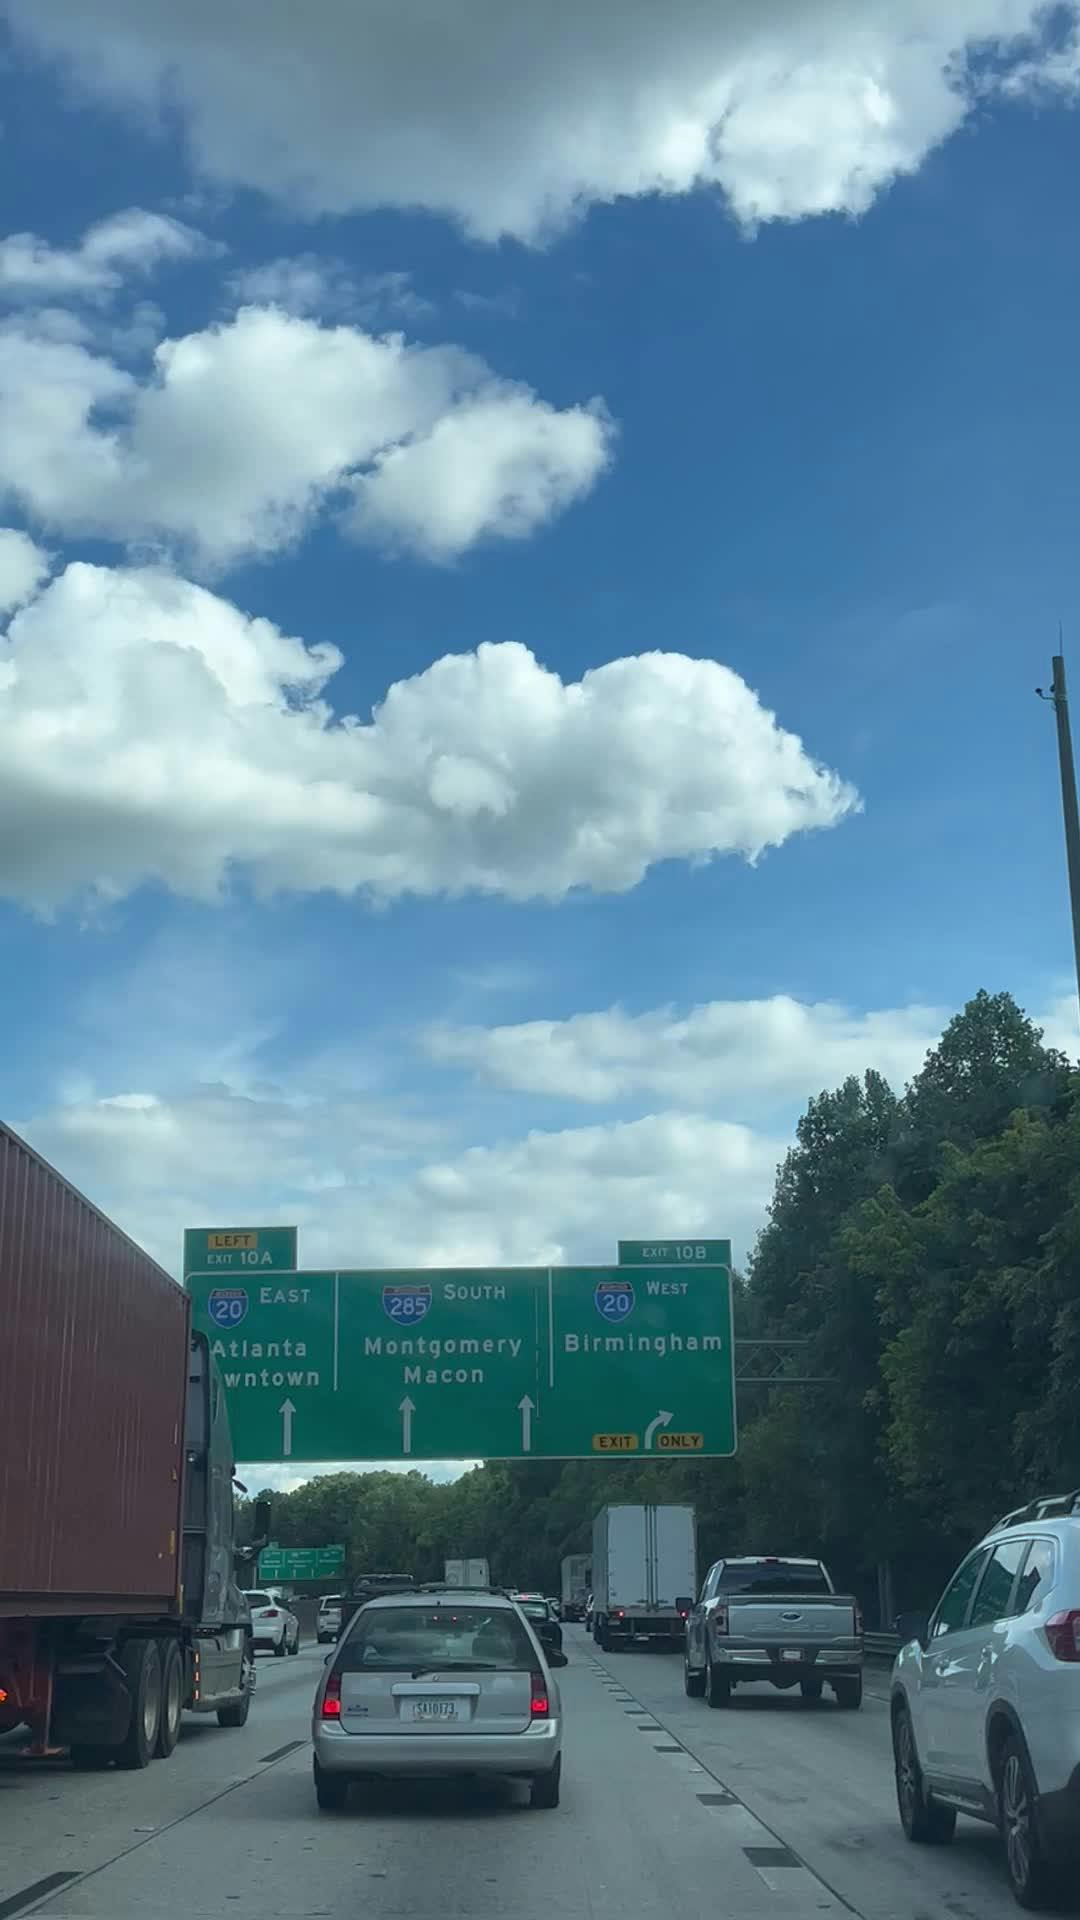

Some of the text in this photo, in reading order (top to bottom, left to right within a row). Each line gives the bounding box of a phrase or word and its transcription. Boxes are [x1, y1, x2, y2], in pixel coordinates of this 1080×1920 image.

[214, 1235, 251, 1248] LEFT
[207, 1251, 273, 1265] EXIT 10A
[642, 1246, 706, 1260] EXIT 10B
[215, 1287, 311, 1319] 20 EAST
[390, 1284, 506, 1316] 285 SOUTH
[602, 1294, 629, 1313] 20
[646, 1281, 689, 1296] WEST
[210, 1339, 307, 1358] Atlanta
[363, 1336, 523, 1359] Montgomery
[564, 1333, 723, 1357] Birmingham
[223, 1369, 321, 1388] wntown
[403, 1366, 484, 1385] Macon
[599, 1435, 700, 1449] EXIT ONLY
